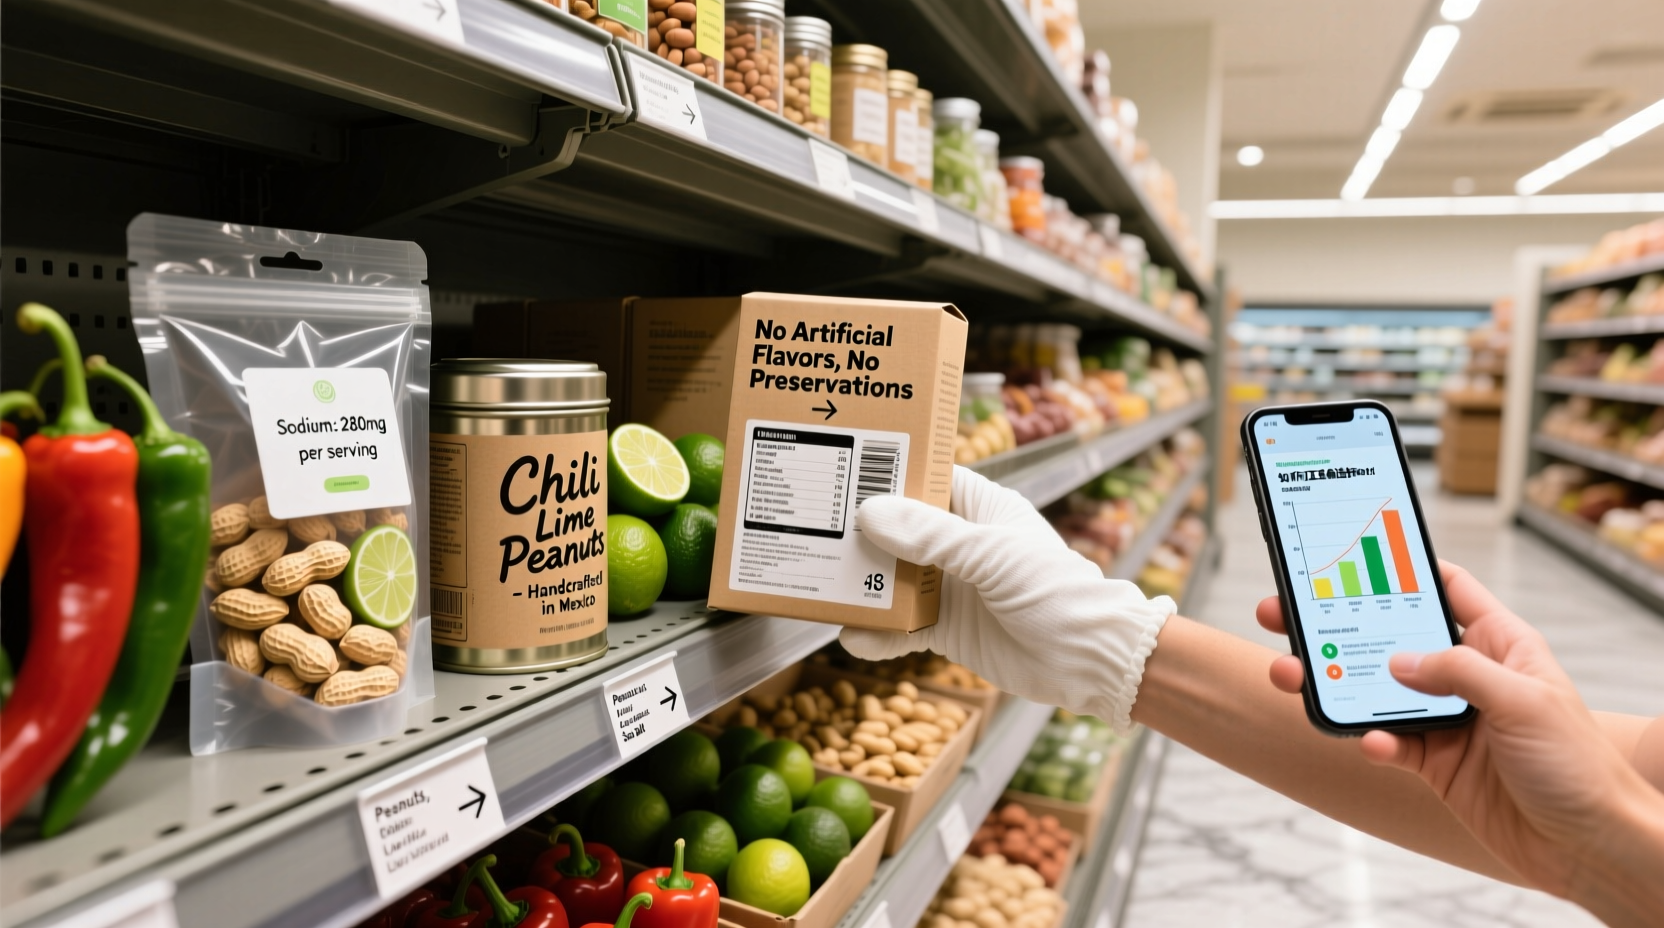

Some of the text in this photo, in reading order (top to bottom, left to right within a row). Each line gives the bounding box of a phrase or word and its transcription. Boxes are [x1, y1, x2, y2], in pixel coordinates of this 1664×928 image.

[755, 319, 894, 346] No Artificial
[752, 344, 880, 373] Flavors, No
[750, 369, 914, 400] Preservations
[277, 416, 387, 435] Sodium: 280mg
[299, 442, 378, 465] per serving
[500, 451, 601, 515] Chili
[535, 506, 595, 543] Lime
[499, 529, 605, 583] Peanuts
[542, 600, 555, 615] in
[375, 789, 430, 825] Peanuts,
